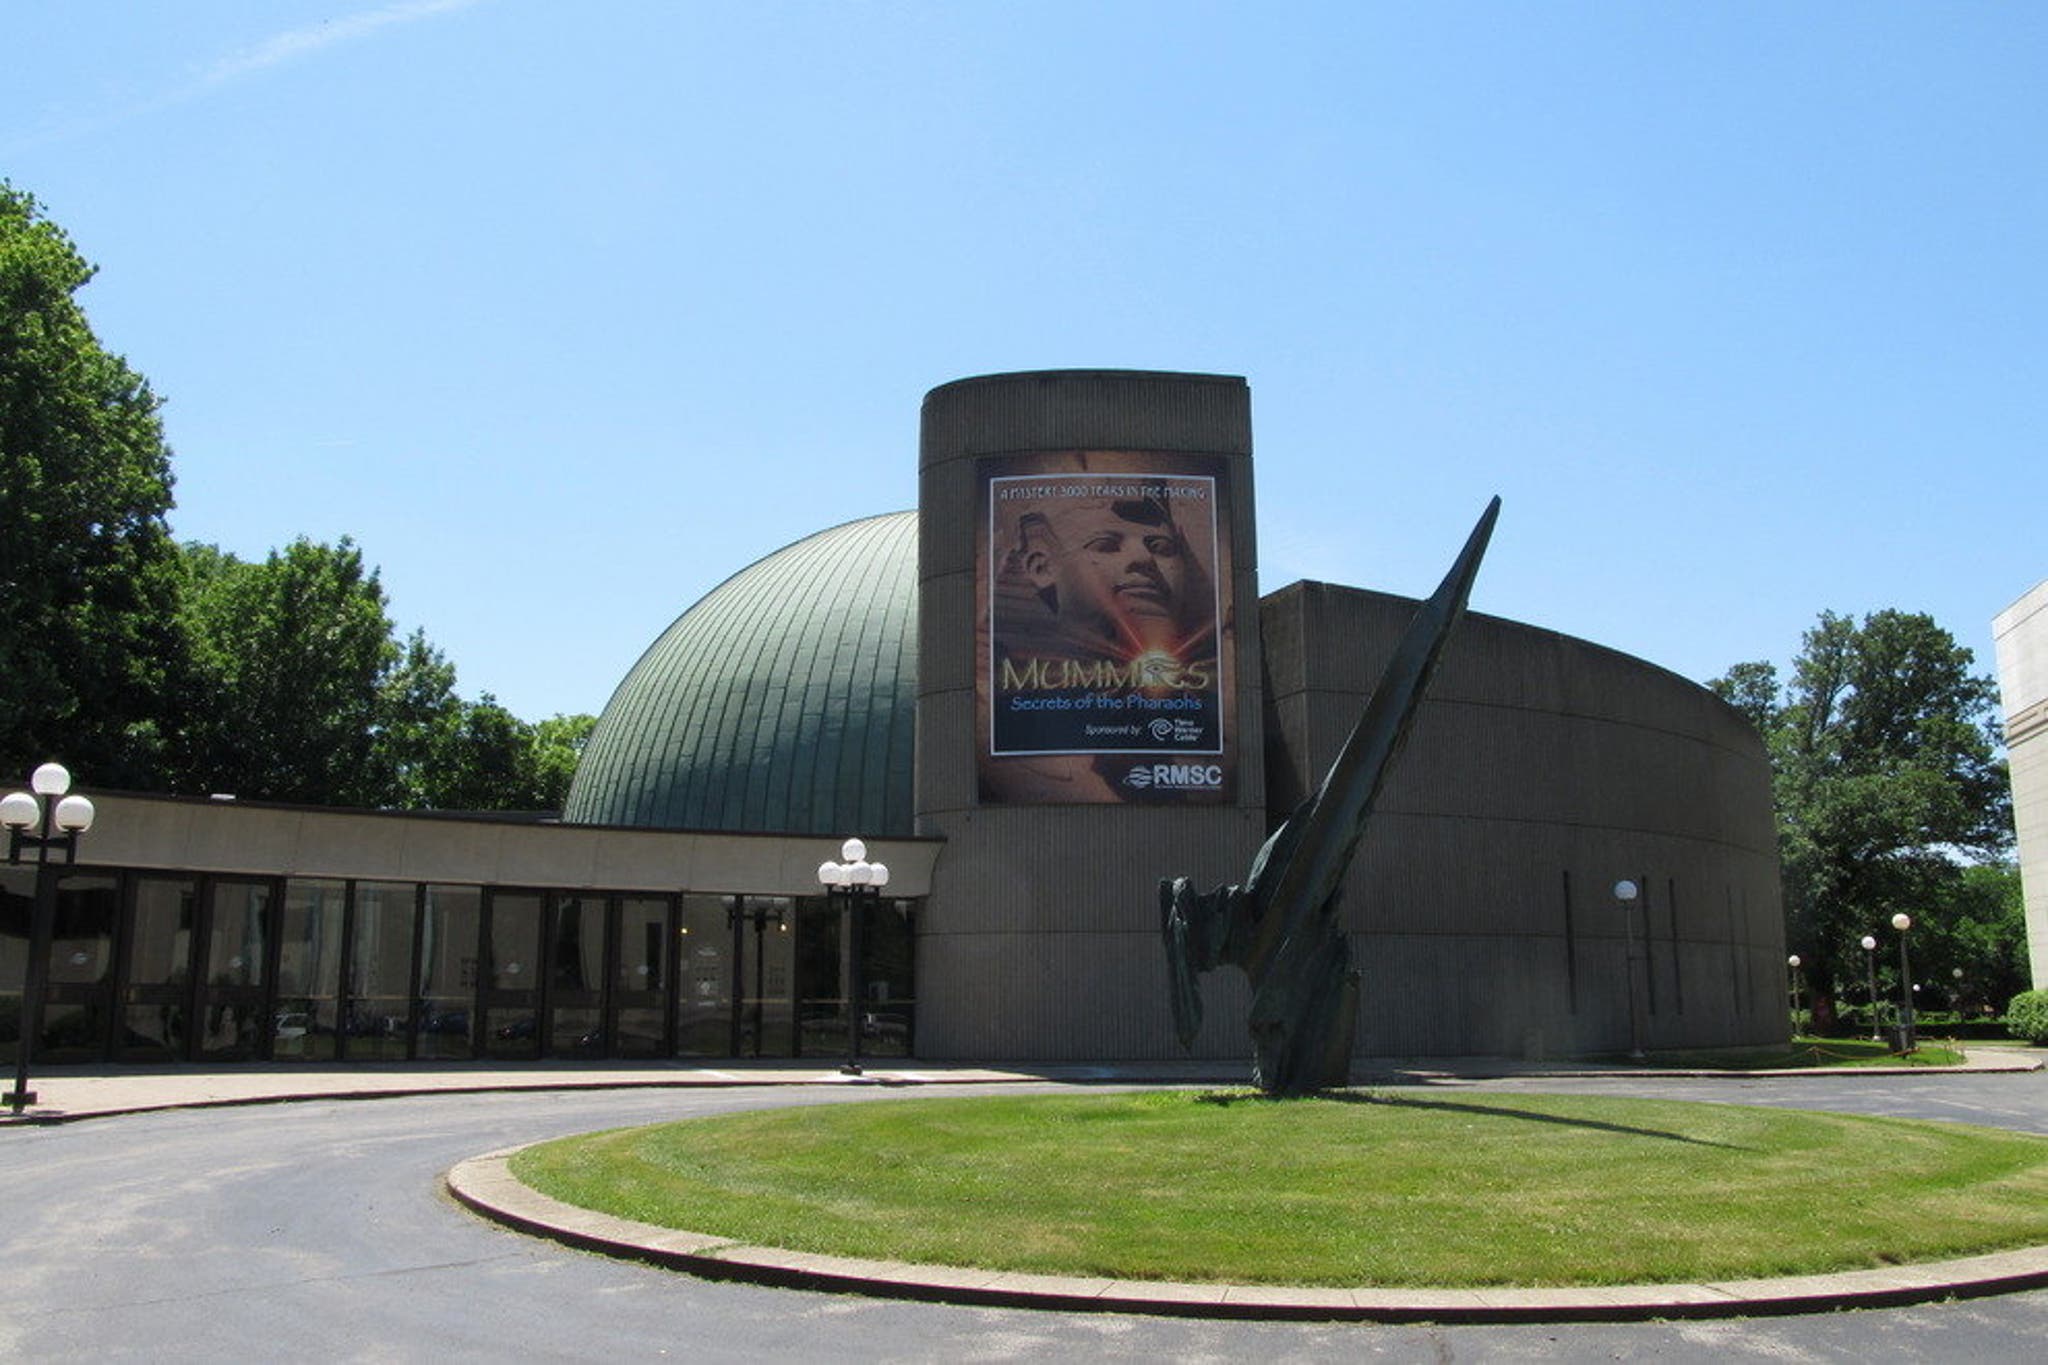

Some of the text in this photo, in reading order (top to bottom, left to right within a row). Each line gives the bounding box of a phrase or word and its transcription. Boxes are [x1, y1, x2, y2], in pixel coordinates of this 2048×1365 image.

[1002, 656, 1209, 690] MUMMIES
[1011, 693, 1203, 711] Secrets of the Pharaohs
[1130, 725, 1142, 736] by
[1154, 764, 1222, 785] RMSC
